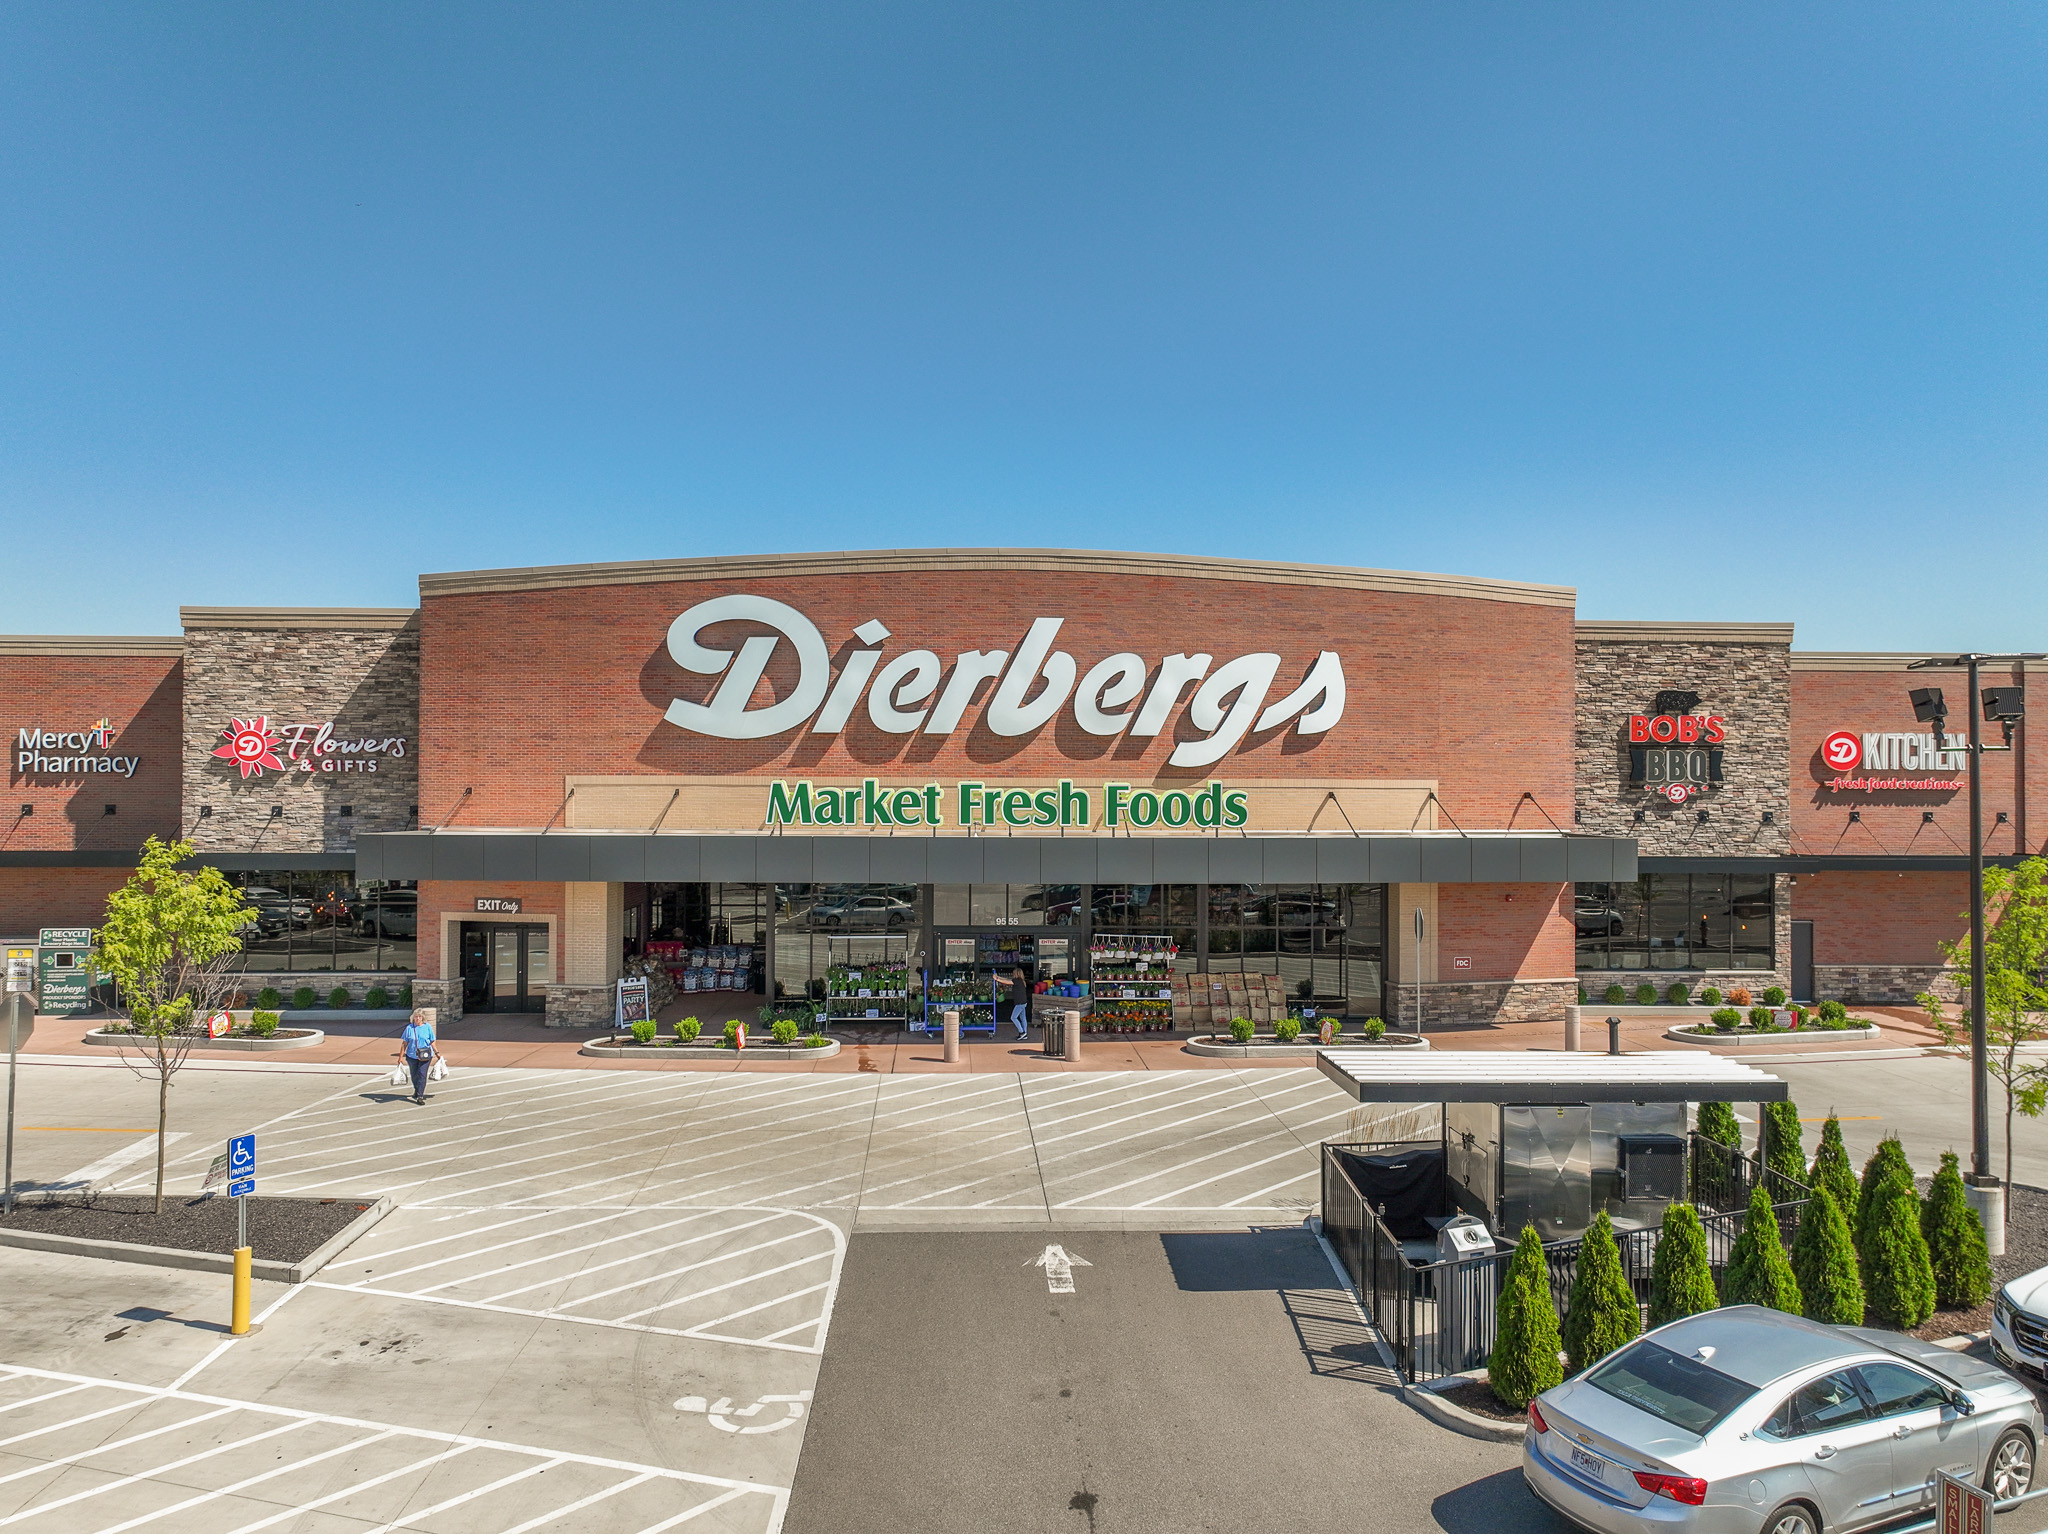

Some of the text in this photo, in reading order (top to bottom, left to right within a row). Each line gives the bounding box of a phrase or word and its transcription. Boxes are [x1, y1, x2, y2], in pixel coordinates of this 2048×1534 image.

[664, 594, 1346, 767] Dierbergs
[19, 728, 94, 754] Mercy
[281, 721, 407, 760] Flowers
[1629, 715, 1724, 743] BOB'S
[18, 750, 139, 778] Pharmacy
[1862, 733, 1966, 770] KITCHEN
[299, 759, 378, 772] & GIFTS
[1646, 750, 1708, 784] BBQ
[765, 777, 1248, 828] Market Fresh Foods
[477, 899, 519, 914] EXIT Only
[995, 918, 1019, 926] 9555
[43, 983, 86, 995] Dierbergs
[623, 995, 645, 1004] PARTY
[53, 1001, 87, 1010] Recycling
[232, 1164, 254, 1176] PARKING
